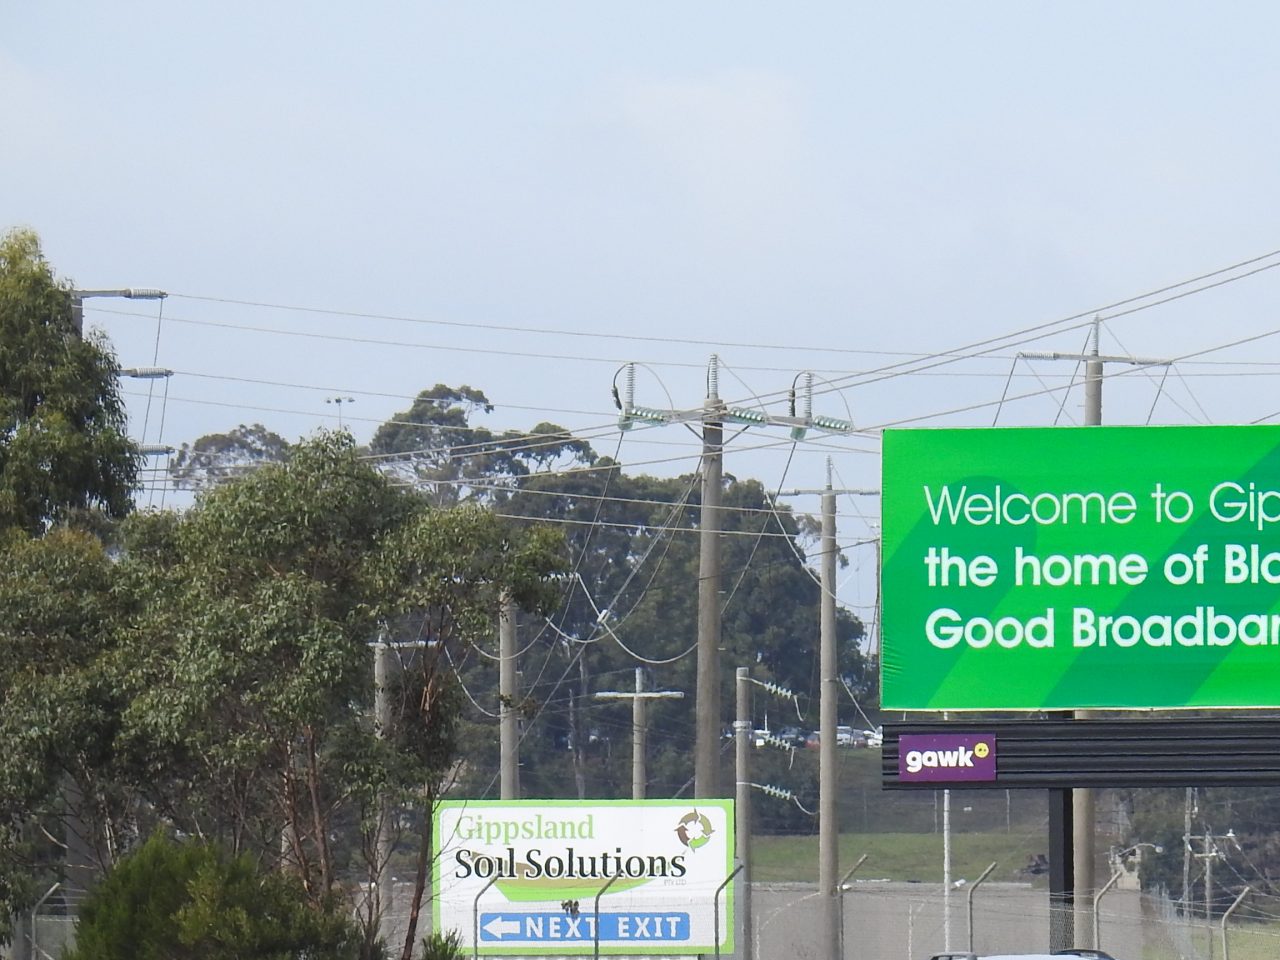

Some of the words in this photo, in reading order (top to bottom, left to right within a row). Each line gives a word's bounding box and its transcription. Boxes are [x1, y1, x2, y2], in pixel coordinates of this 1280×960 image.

[924, 484, 1137, 526] Welcome
[1154, 482, 1194, 523] to
[924, 547, 998, 587] the
[1015, 546, 1148, 586] home
[1164, 544, 1208, 586] of
[924, 607, 1055, 649] Good
[906, 746, 974, 773] gawk
[456, 814, 595, 845] Gippsland
[455, 848, 517, 879] Soil
[525, 847, 687, 879] Solutions
[526, 916, 599, 938] NEXT
[618, 916, 681, 938] EXIT
